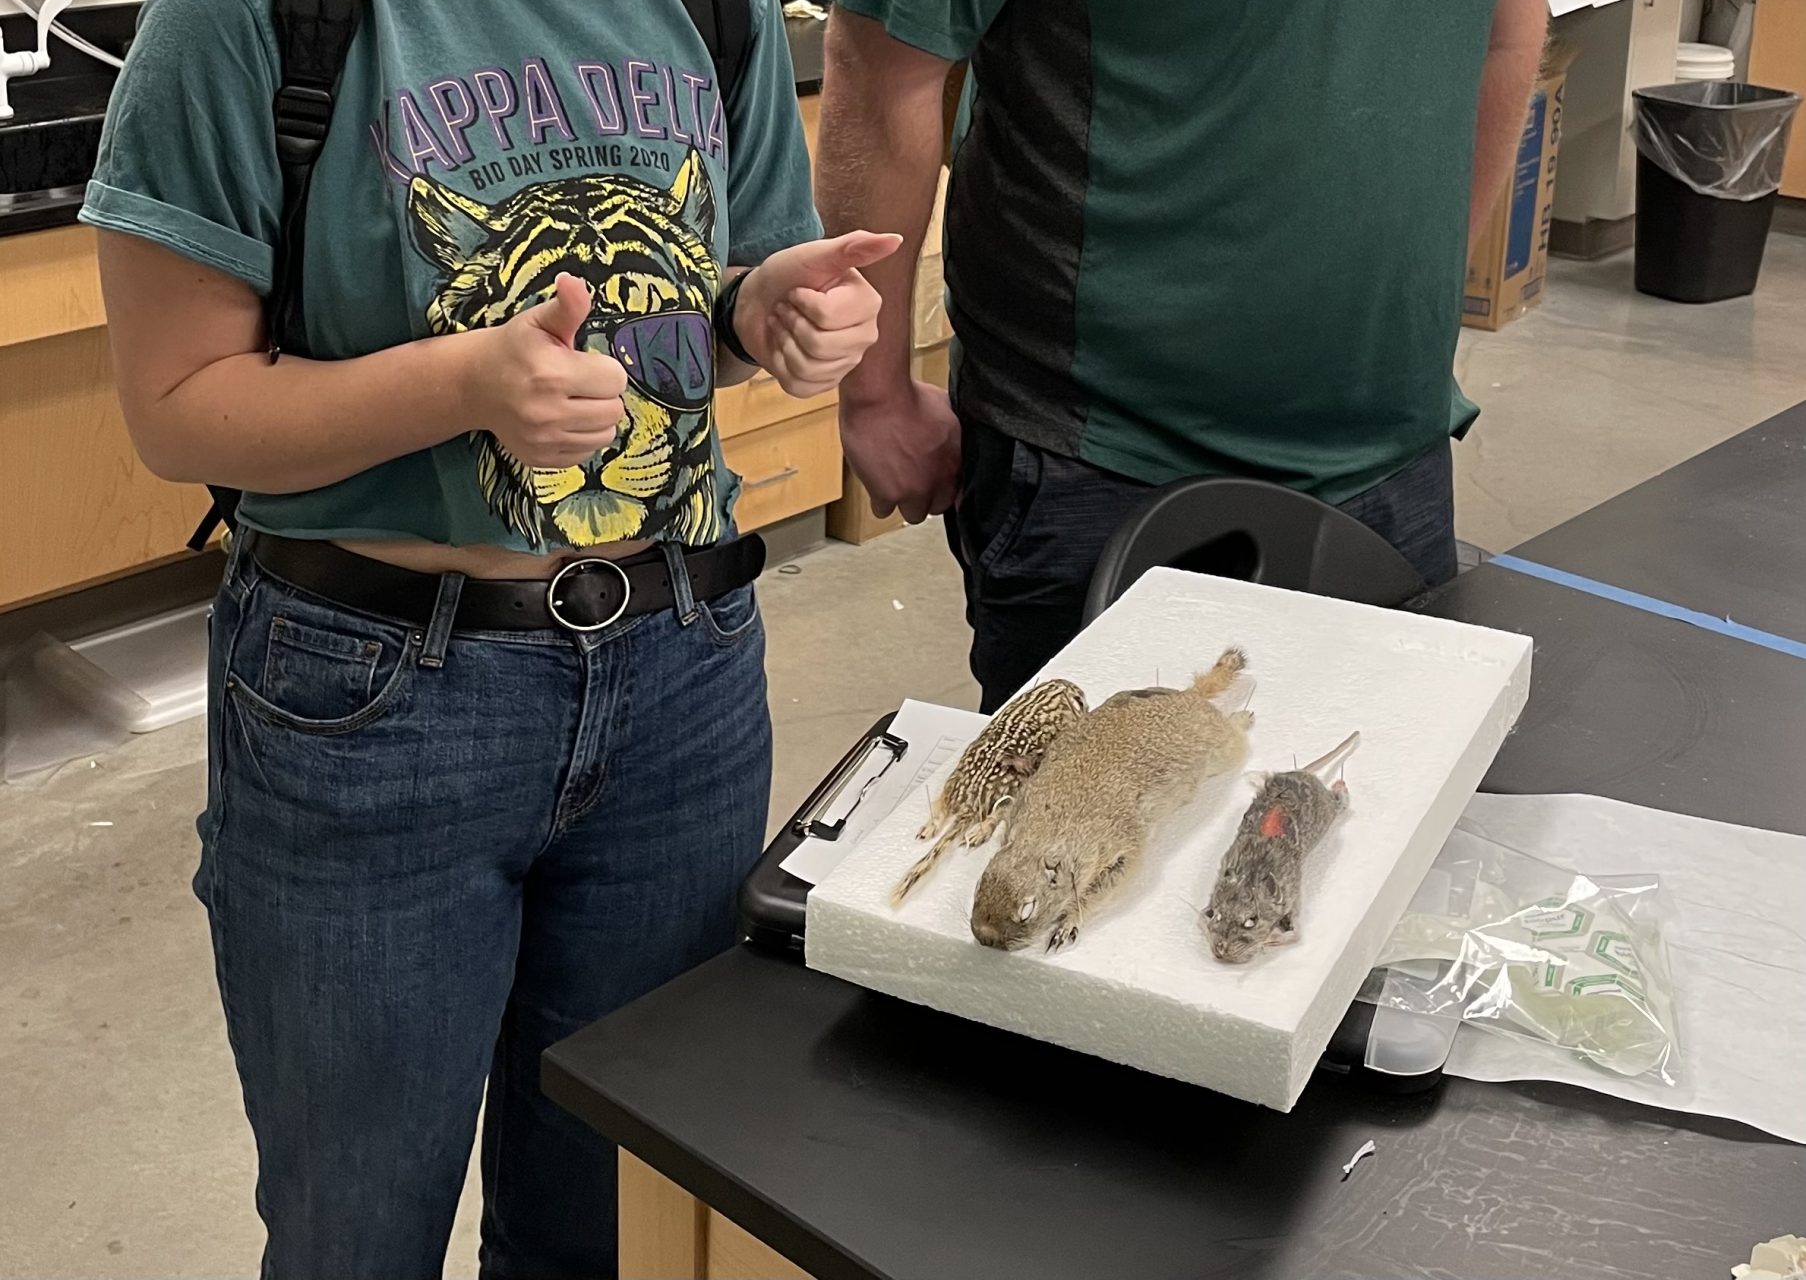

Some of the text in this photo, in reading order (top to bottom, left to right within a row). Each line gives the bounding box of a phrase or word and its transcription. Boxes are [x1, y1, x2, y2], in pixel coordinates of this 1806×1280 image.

[370, 57, 728, 184] KAPPA DELTA
[469, 144, 670, 191] BID DAY SPRING 2020
